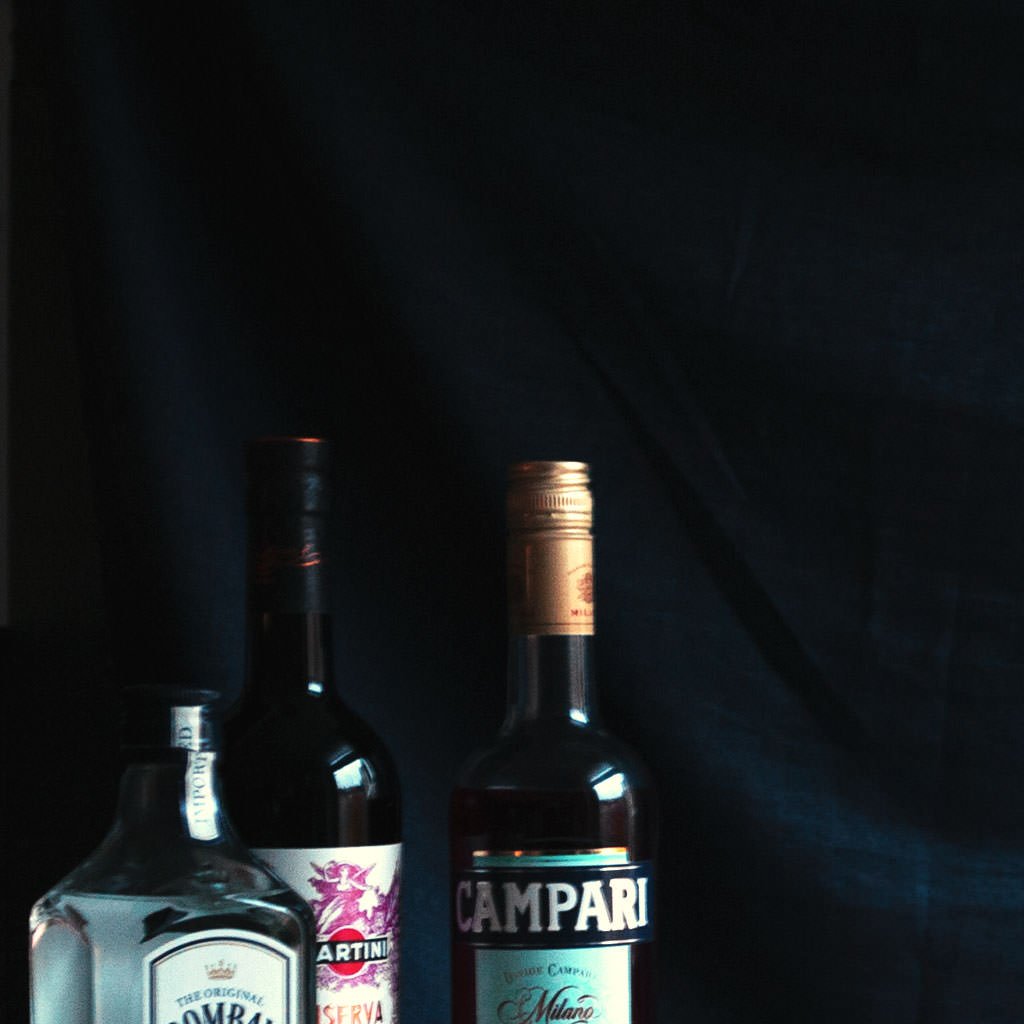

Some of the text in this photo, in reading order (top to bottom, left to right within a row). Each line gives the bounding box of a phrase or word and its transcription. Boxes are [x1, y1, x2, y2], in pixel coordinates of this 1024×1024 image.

[456, 877, 649, 933] CAMPARI
[316, 940, 387, 962] ARTINI
[175, 988, 264, 1008] THE ORIGINAL
